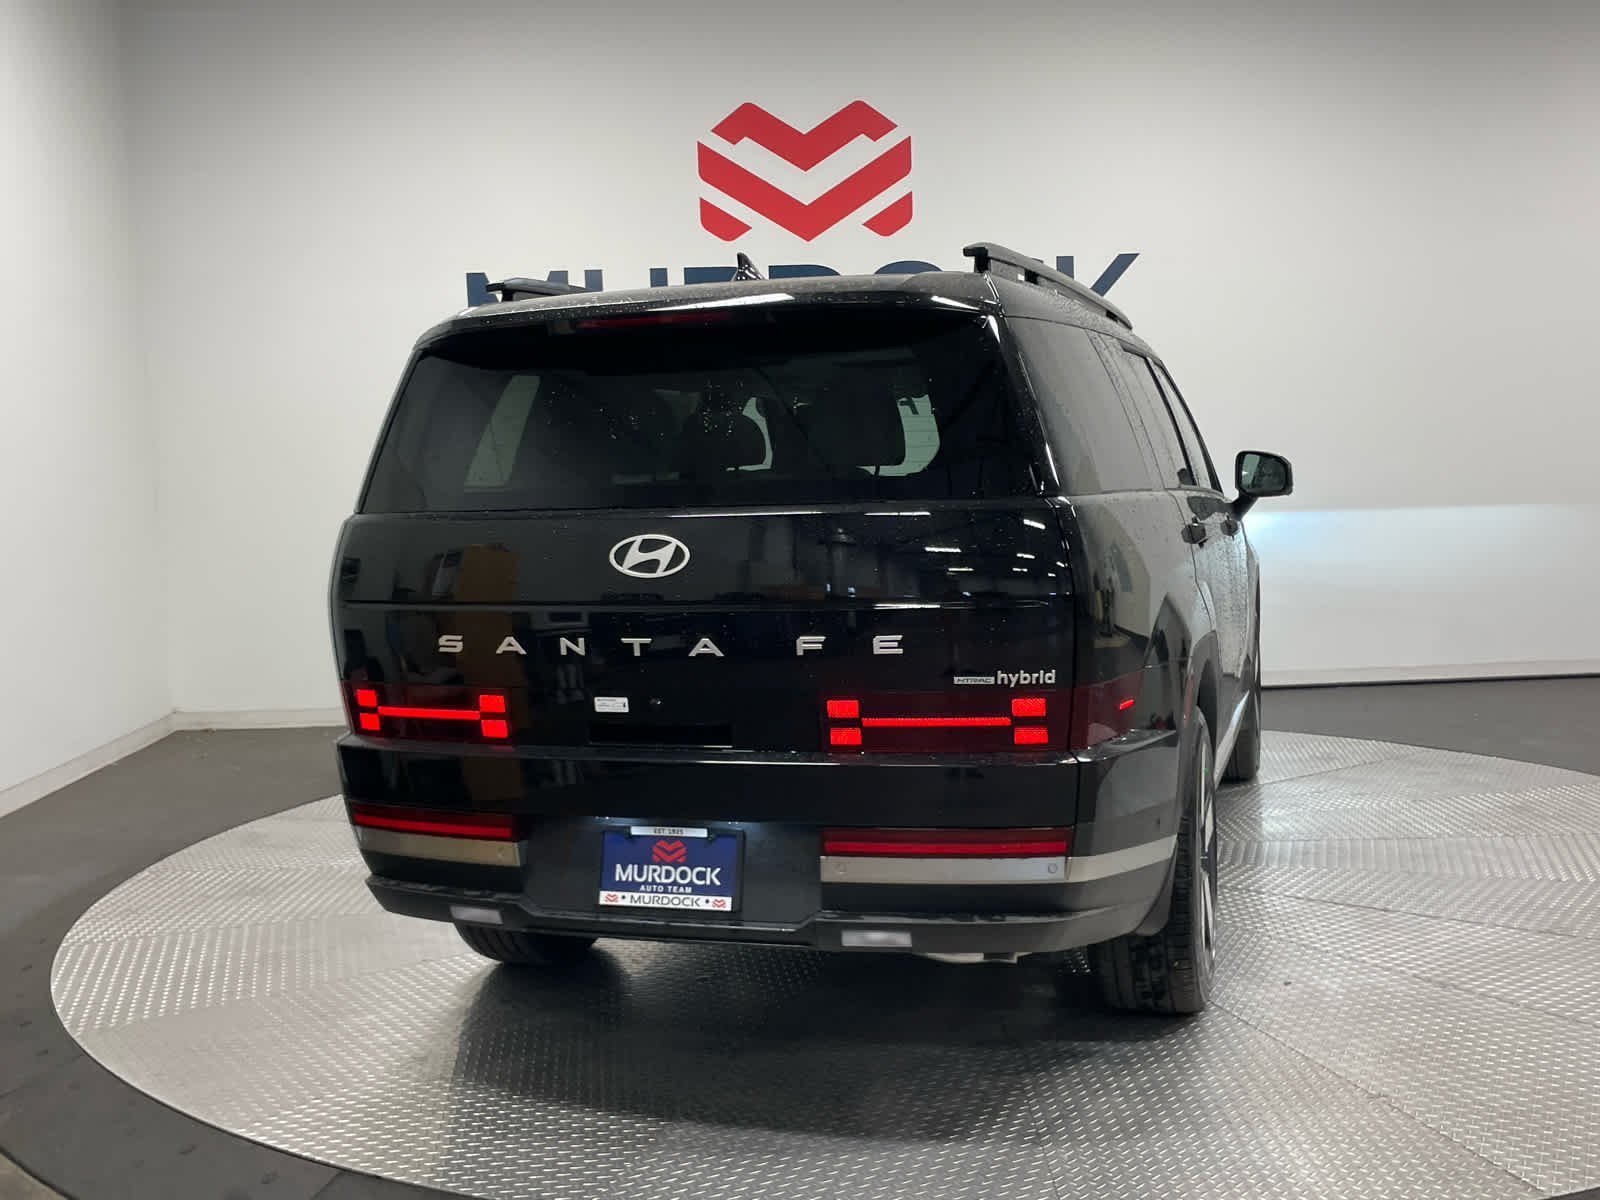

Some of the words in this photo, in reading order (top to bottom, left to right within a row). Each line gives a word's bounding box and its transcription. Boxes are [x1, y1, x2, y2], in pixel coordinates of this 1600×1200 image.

[438, 634, 724, 657] SANTA
[796, 634, 904, 656] FE
[997, 670, 1056, 688] hybrid
[615, 863, 721, 886] MURDOCK
[639, 885, 664, 893] AUTO
[667, 886, 692, 894] TEAM
[630, 894, 701, 908] MURDOCK
